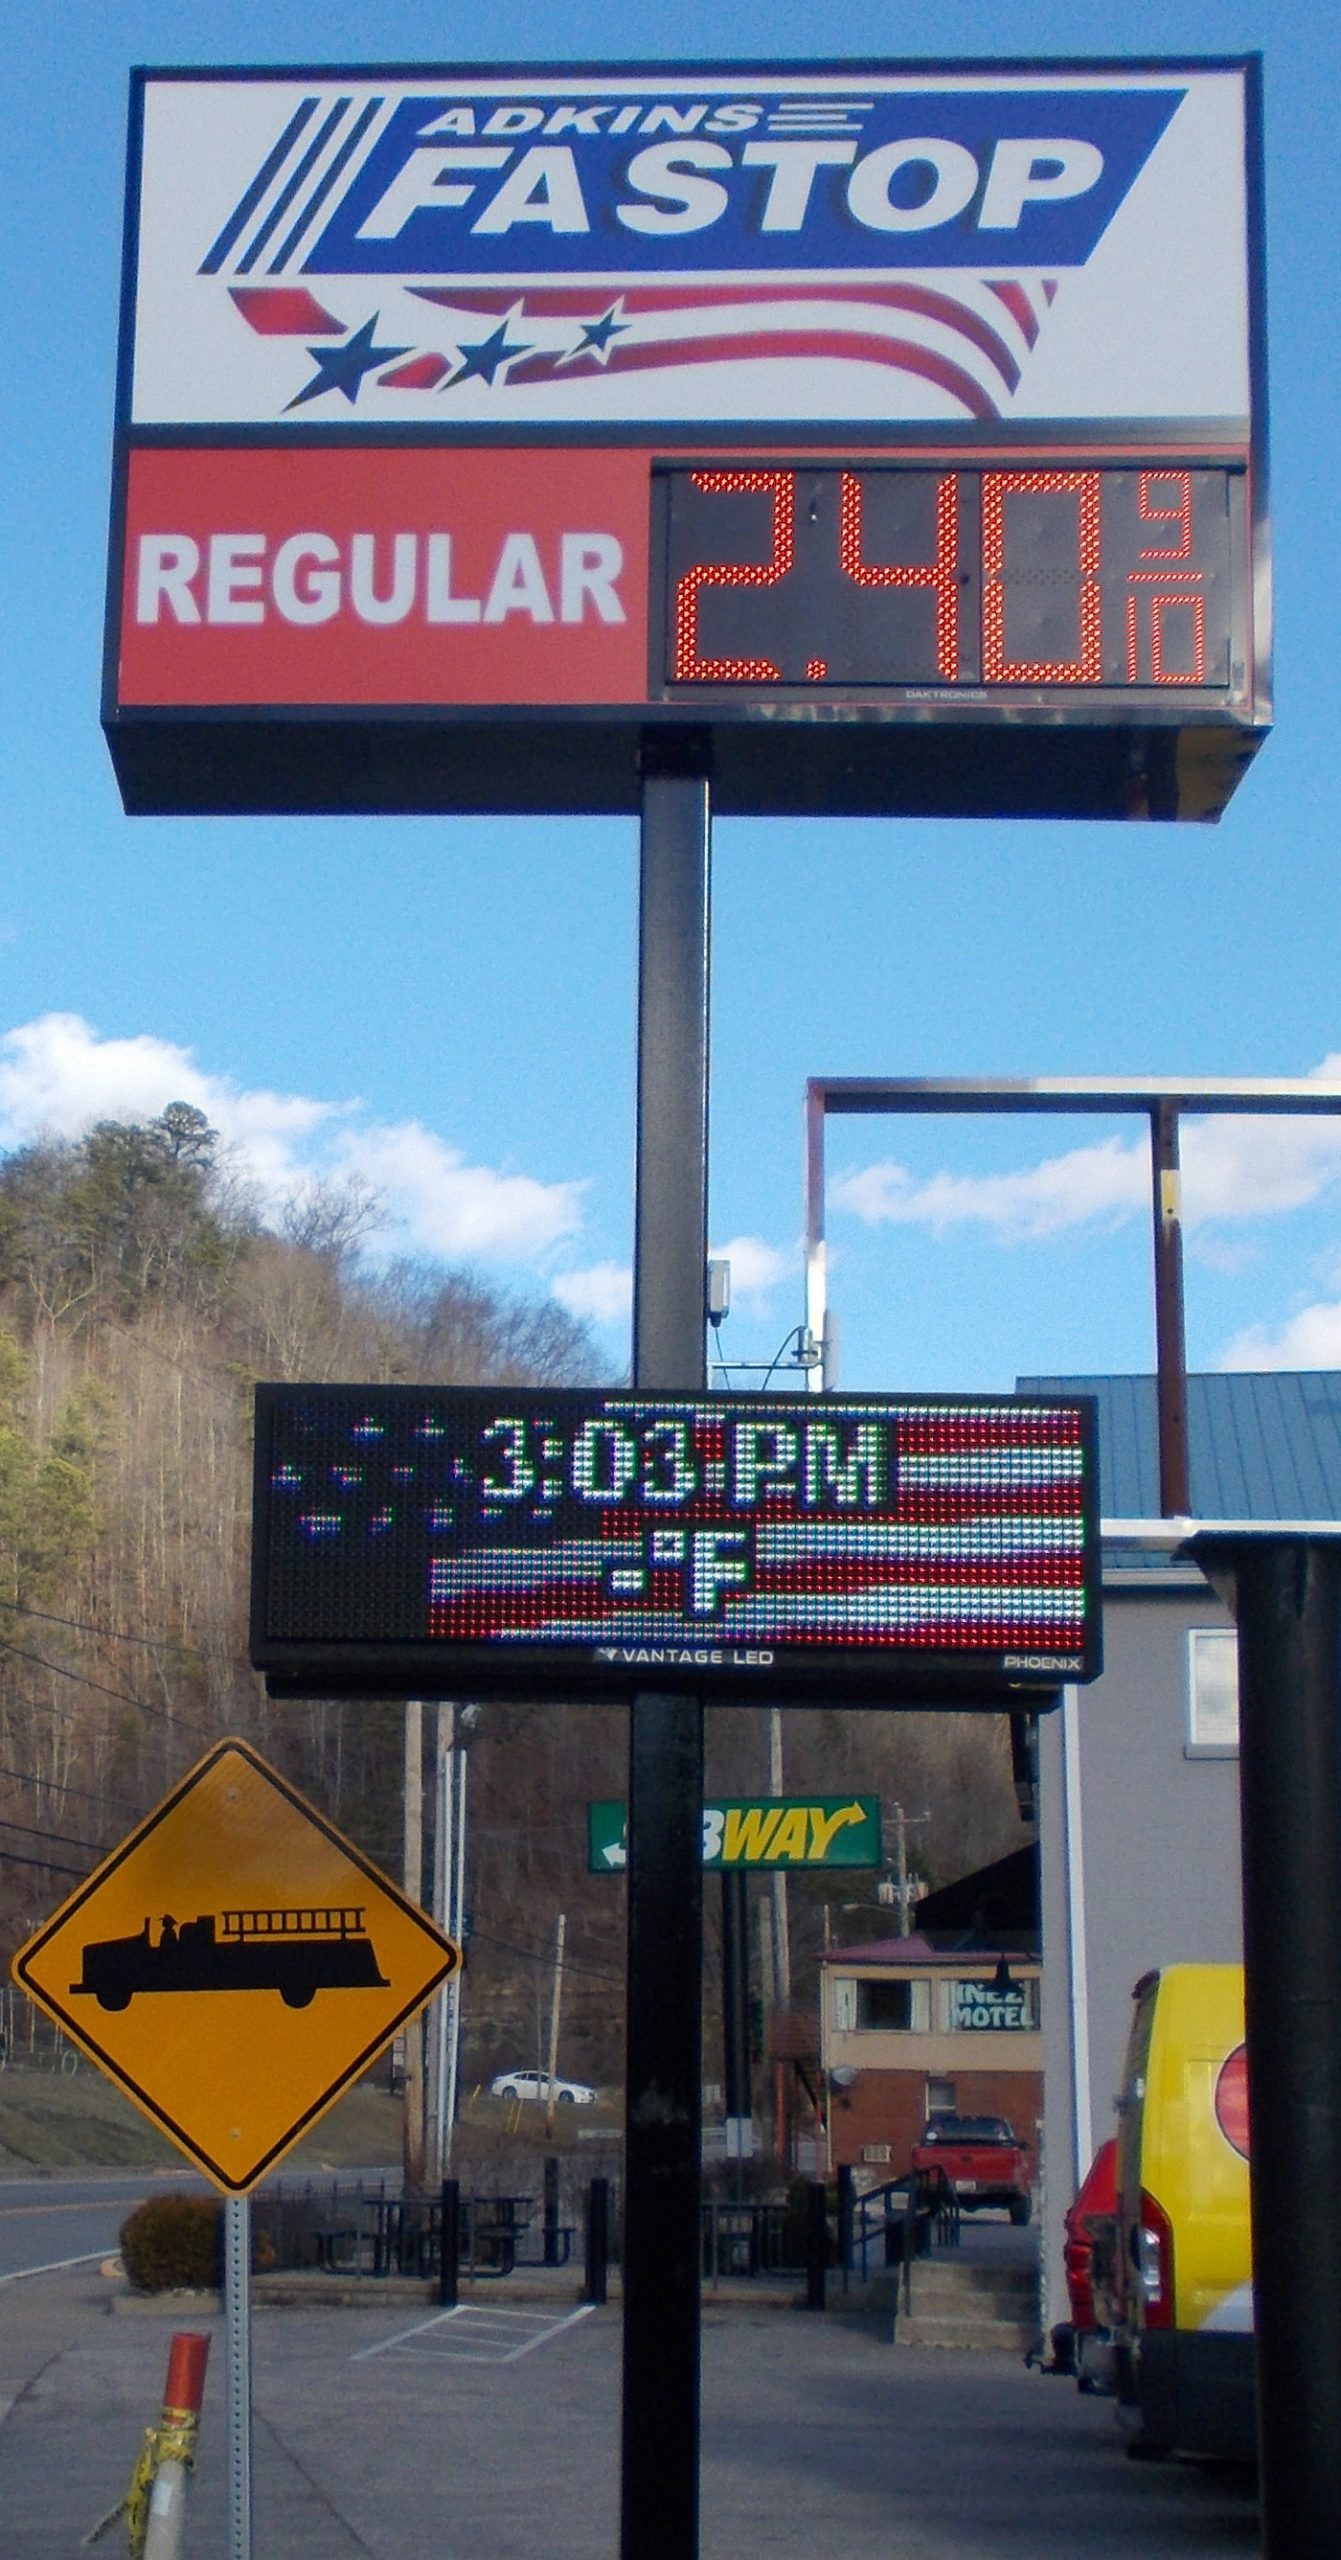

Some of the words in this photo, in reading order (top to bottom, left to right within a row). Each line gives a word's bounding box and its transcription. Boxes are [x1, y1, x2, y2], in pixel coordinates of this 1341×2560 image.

[416, 103, 764, 136] ADKINS
[355, 139, 1103, 239] FASTOP
[136, 532, 627, 625] REGULAR
[675, 471, 1102, 684] 2.40
[905, 690, 987, 699] DAKTRONICS
[481, 1417, 698, 1501] 3:03
[732, 1421, 889, 1506] PM
[622, 1648, 723, 1664] VANTAGE
[733, 1650, 774, 1665] LED
[1004, 1655, 1081, 1670] PHOENIX
[951, 2006, 1034, 2028] MOTEL
